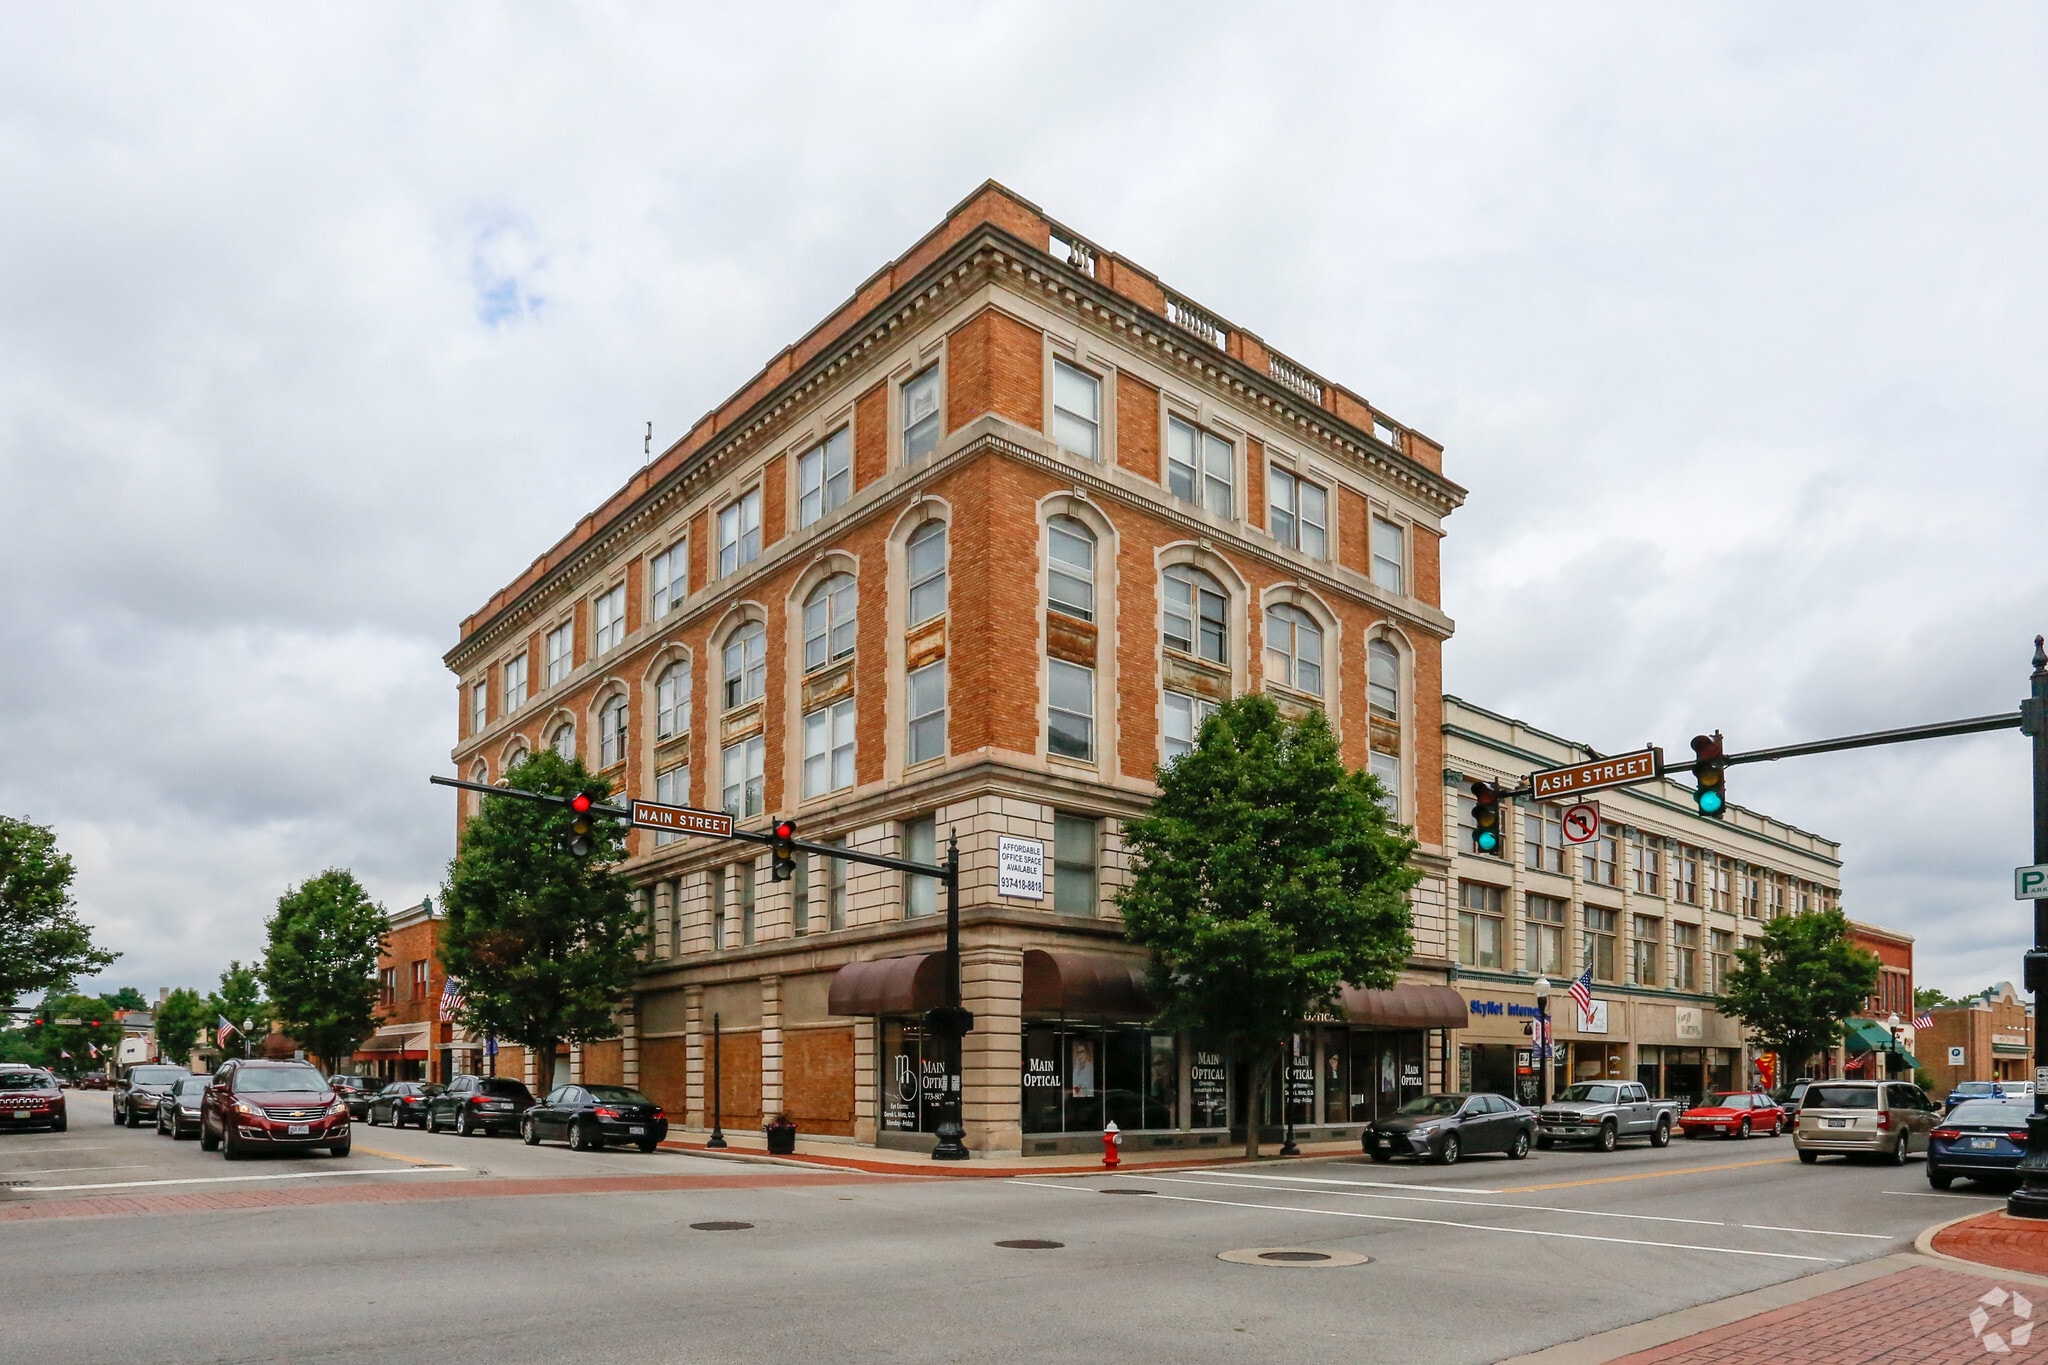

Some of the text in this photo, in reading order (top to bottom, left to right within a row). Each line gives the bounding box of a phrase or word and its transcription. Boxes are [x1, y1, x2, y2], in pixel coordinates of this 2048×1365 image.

[1540, 758, 1648, 792] ASH STREET
[639, 808, 728, 832] MAIN STREET
[1003, 843, 1040, 855] AFFORDABLE
[1002, 853, 1041, 865] OFFICE SPACE
[1007, 864, 1037, 874] AVAILABLE
[1001, 877, 1042, 892] 937-418-8818
[1470, 1000, 1503, 1018] SkyNet
[1198, 1052, 1220, 1065] MAIN
[923, 1061, 945, 1074] MAIN
[1030, 1059, 1054, 1072] MAIN
[1405, 1064, 1419, 1075] MAIN
[1191, 1066, 1225, 1080] OPTICAL
[1023, 1073, 1061, 1087] OPTICAL
[1402, 1075, 1422, 1086] OPTICAL
